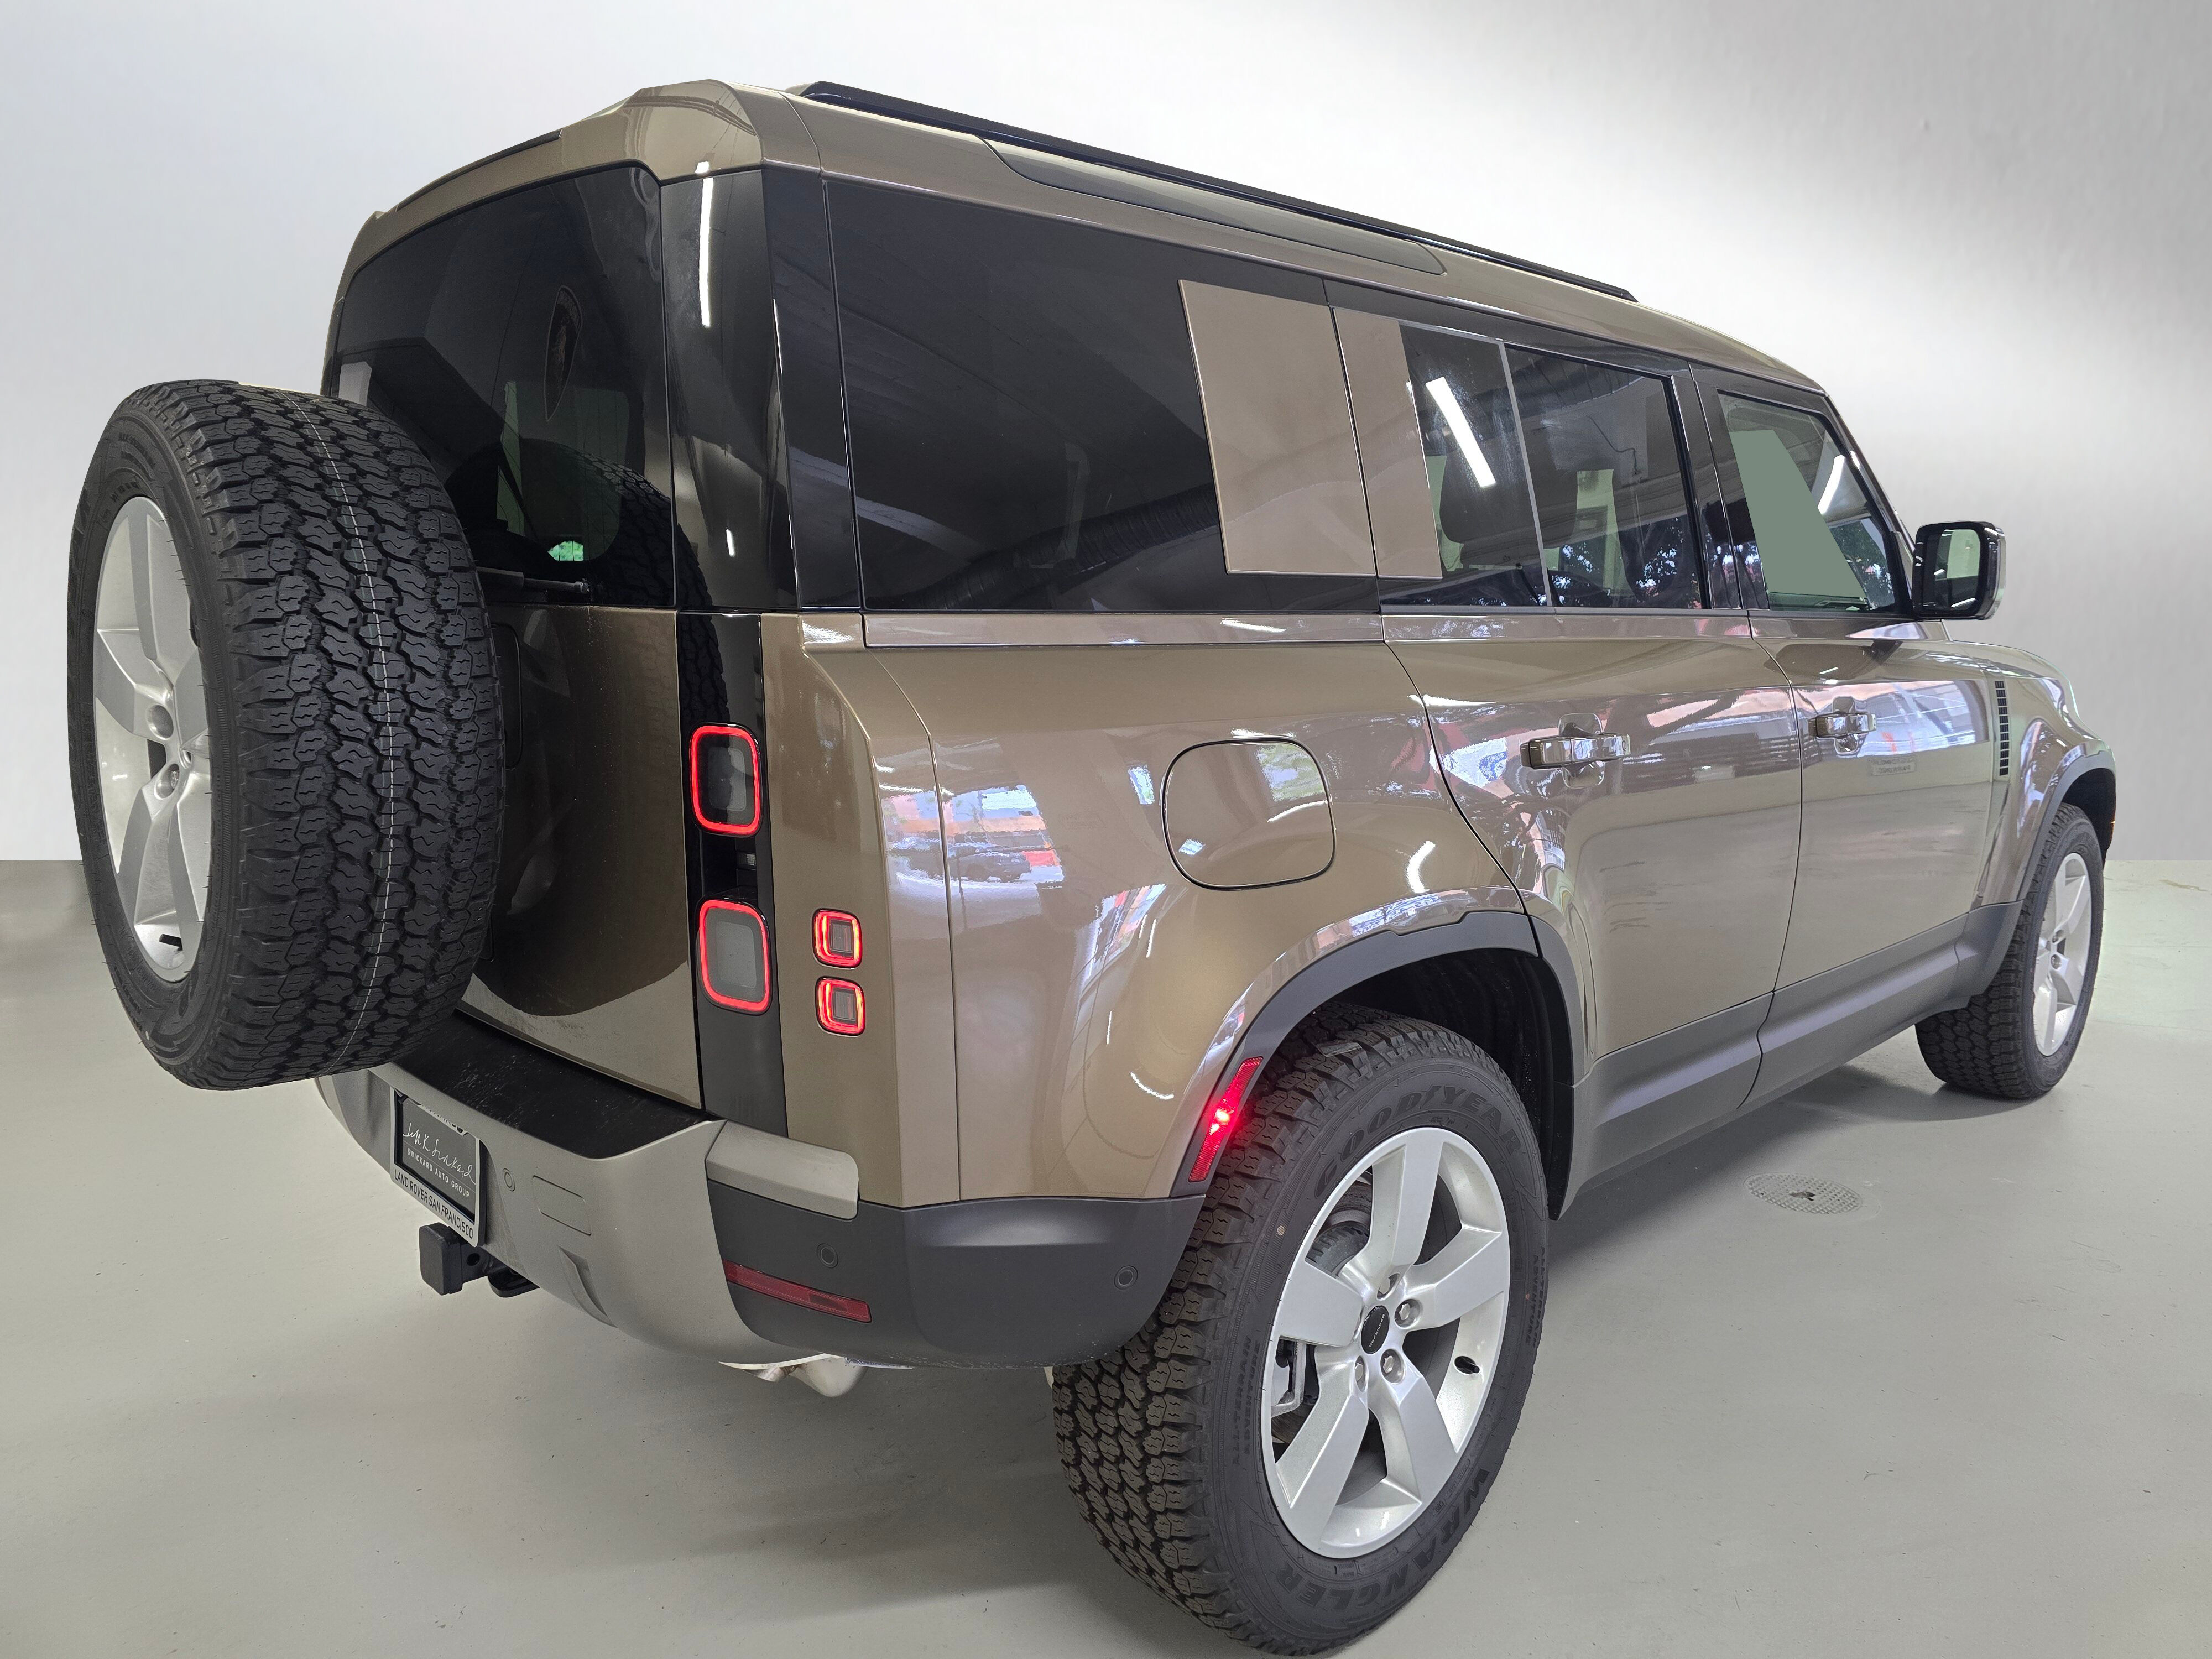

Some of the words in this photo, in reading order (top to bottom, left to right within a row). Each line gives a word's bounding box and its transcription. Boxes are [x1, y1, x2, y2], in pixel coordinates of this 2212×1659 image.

[407, 1147, 432, 1172] SWICKARD
[435, 1168, 449, 1183] AUTO
[451, 1180, 469, 1198] GROUP
[1315, 1085, 1522, 1199] GOODYEAR
[394, 1168, 409, 1188] LAND
[410, 1181, 428, 1204] ROVER
[429, 1195, 441, 1213] SAN
[441, 1205, 473, 1240] FRANCISCO
[1369, 1313, 1385, 1348] DEFENDER
[1277, 1468, 1490, 1610] WRANGLER
